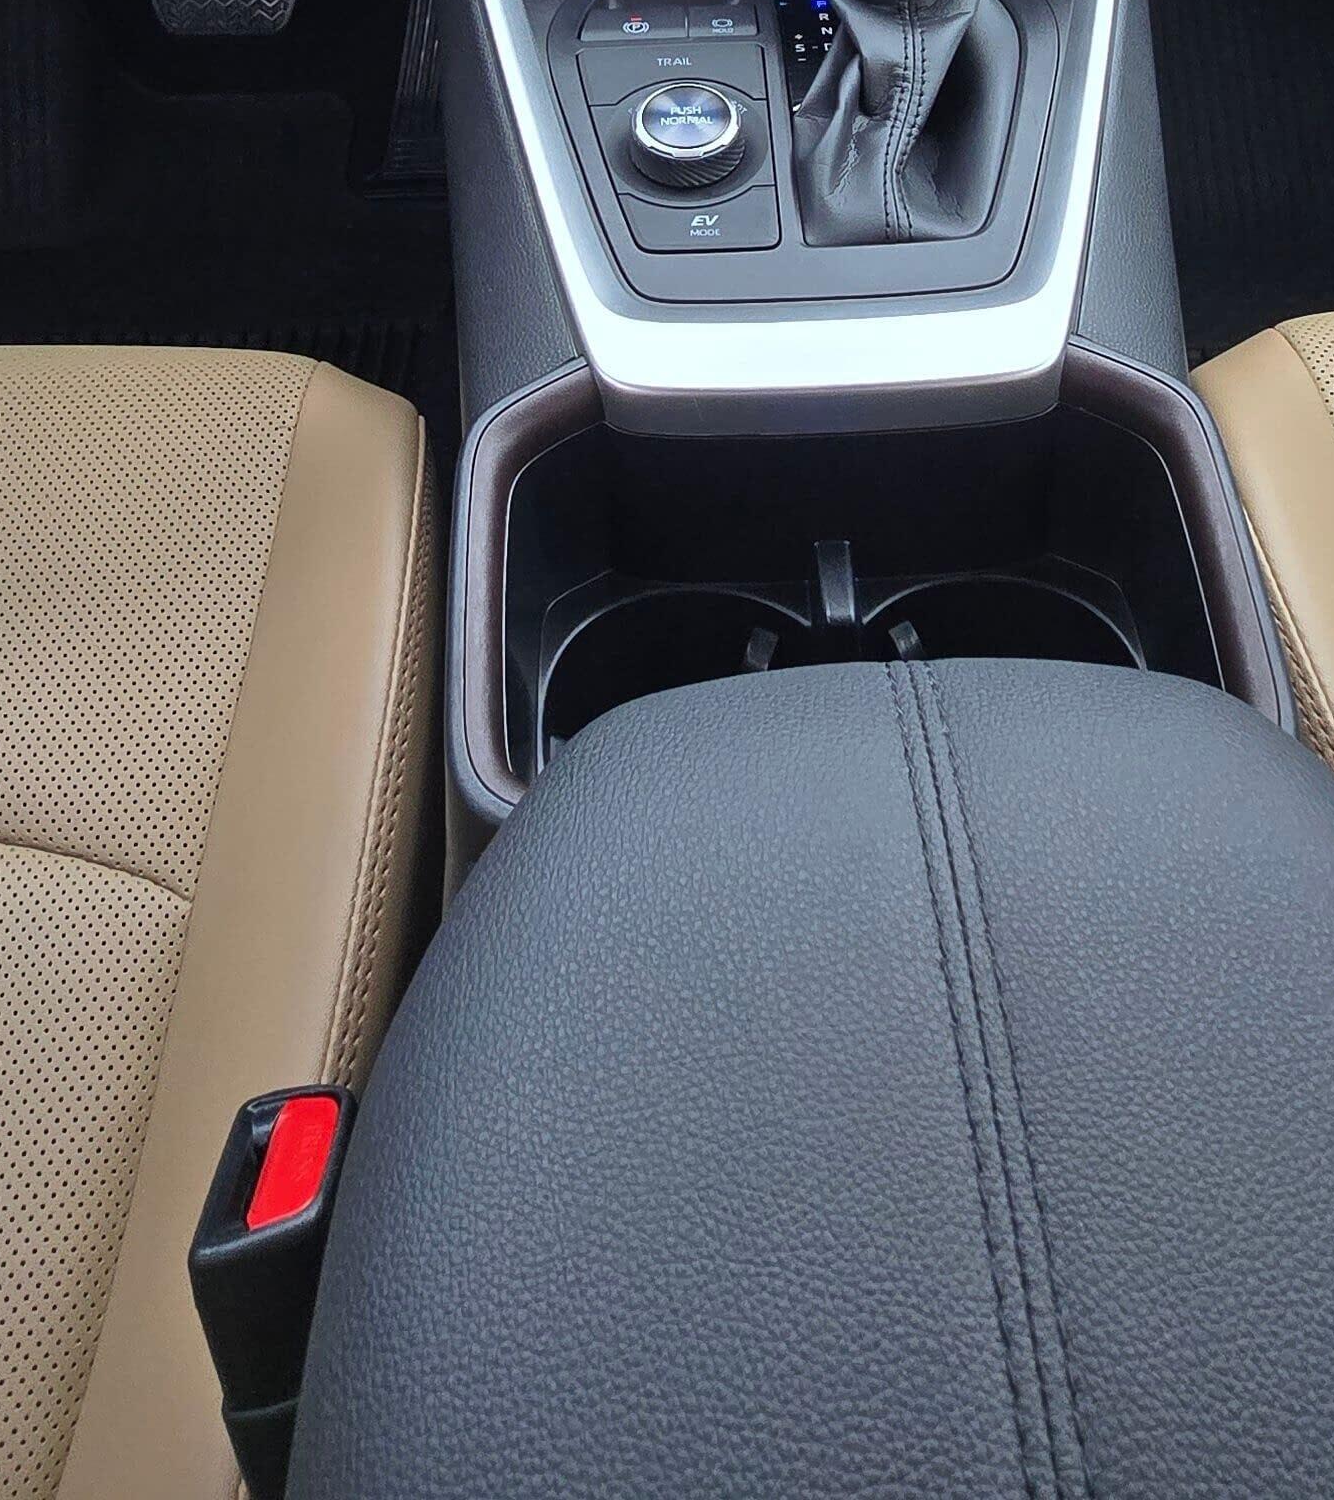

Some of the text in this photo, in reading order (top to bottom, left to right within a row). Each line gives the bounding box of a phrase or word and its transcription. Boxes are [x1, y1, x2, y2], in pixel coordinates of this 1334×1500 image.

[818, 13, 830, 21] R
[820, 26, 833, 35] N
[795, 43, 806, 53] S
[657, 56, 692, 67] TRAIL
[670, 106, 701, 115] PUSH
[660, 116, 714, 126] NORMAL
[690, 214, 719, 227] EV
